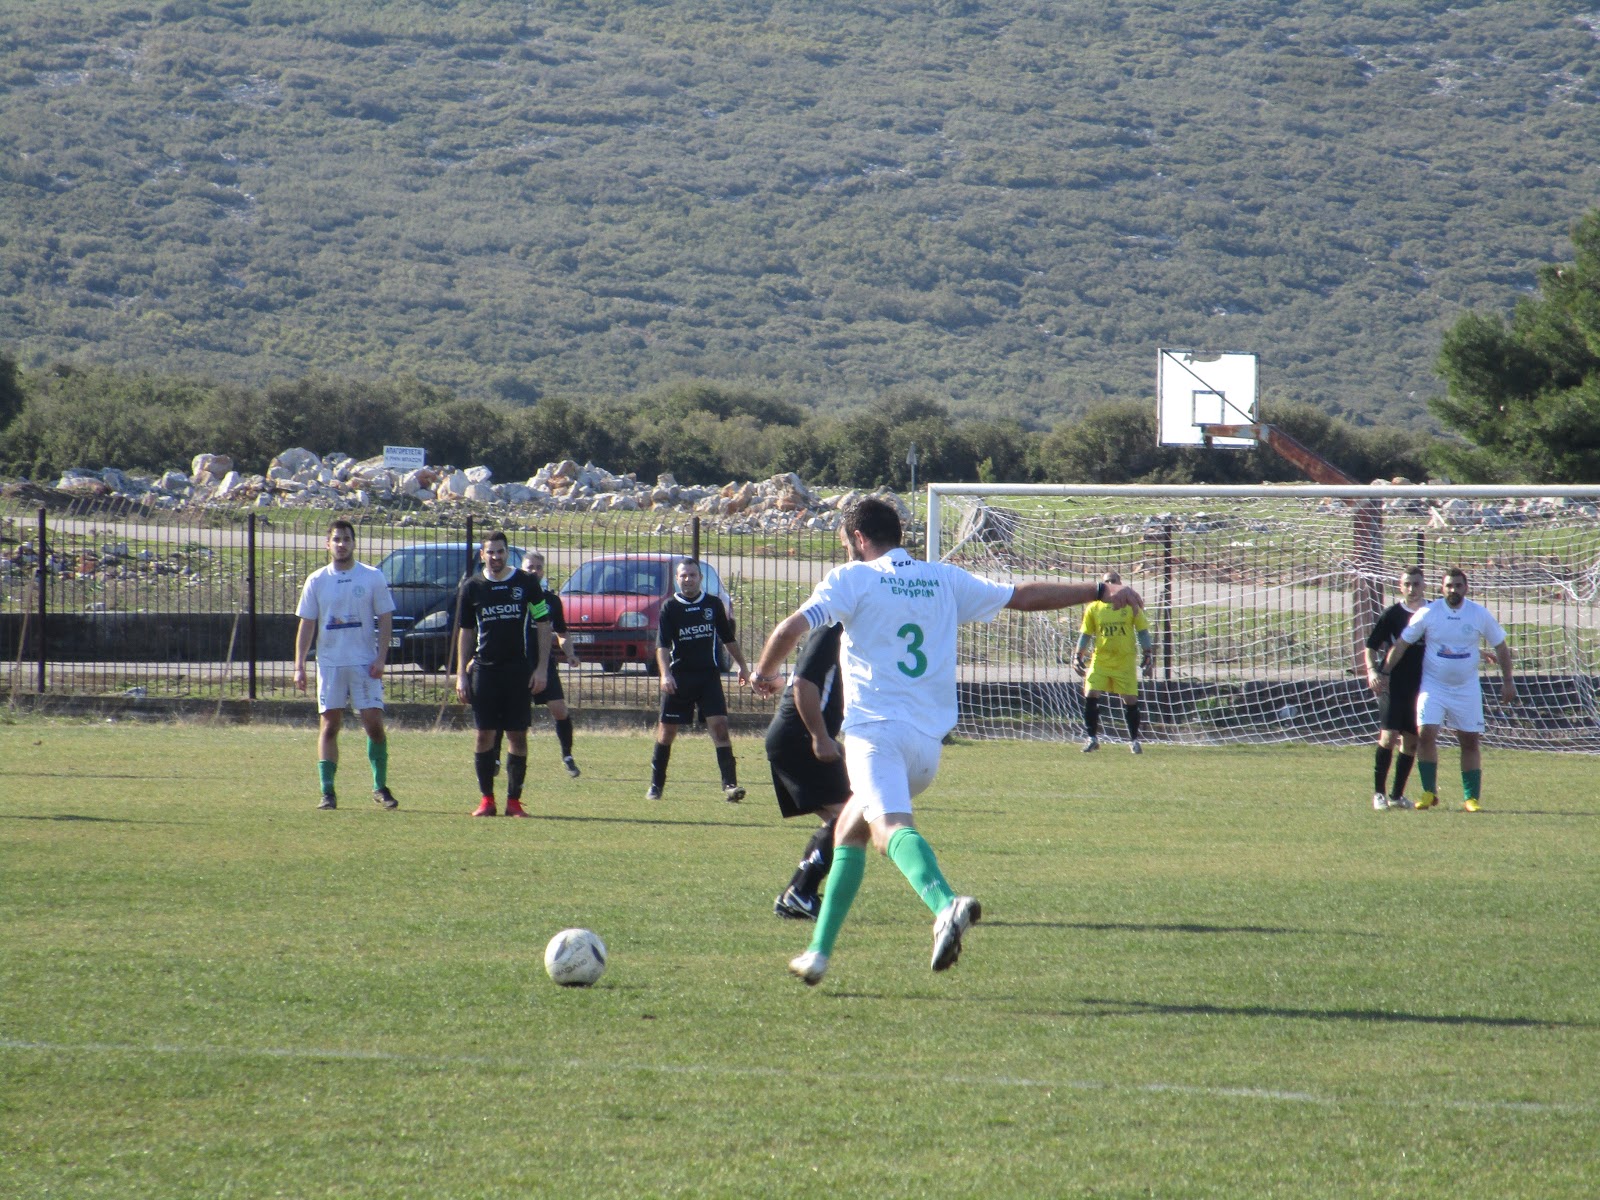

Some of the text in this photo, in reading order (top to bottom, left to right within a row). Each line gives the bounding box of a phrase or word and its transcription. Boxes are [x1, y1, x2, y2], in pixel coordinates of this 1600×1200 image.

[481, 603, 521, 617] AKSOIL
[678, 623, 713, 637] AKSOIL
[896, 622, 928, 679] 3
